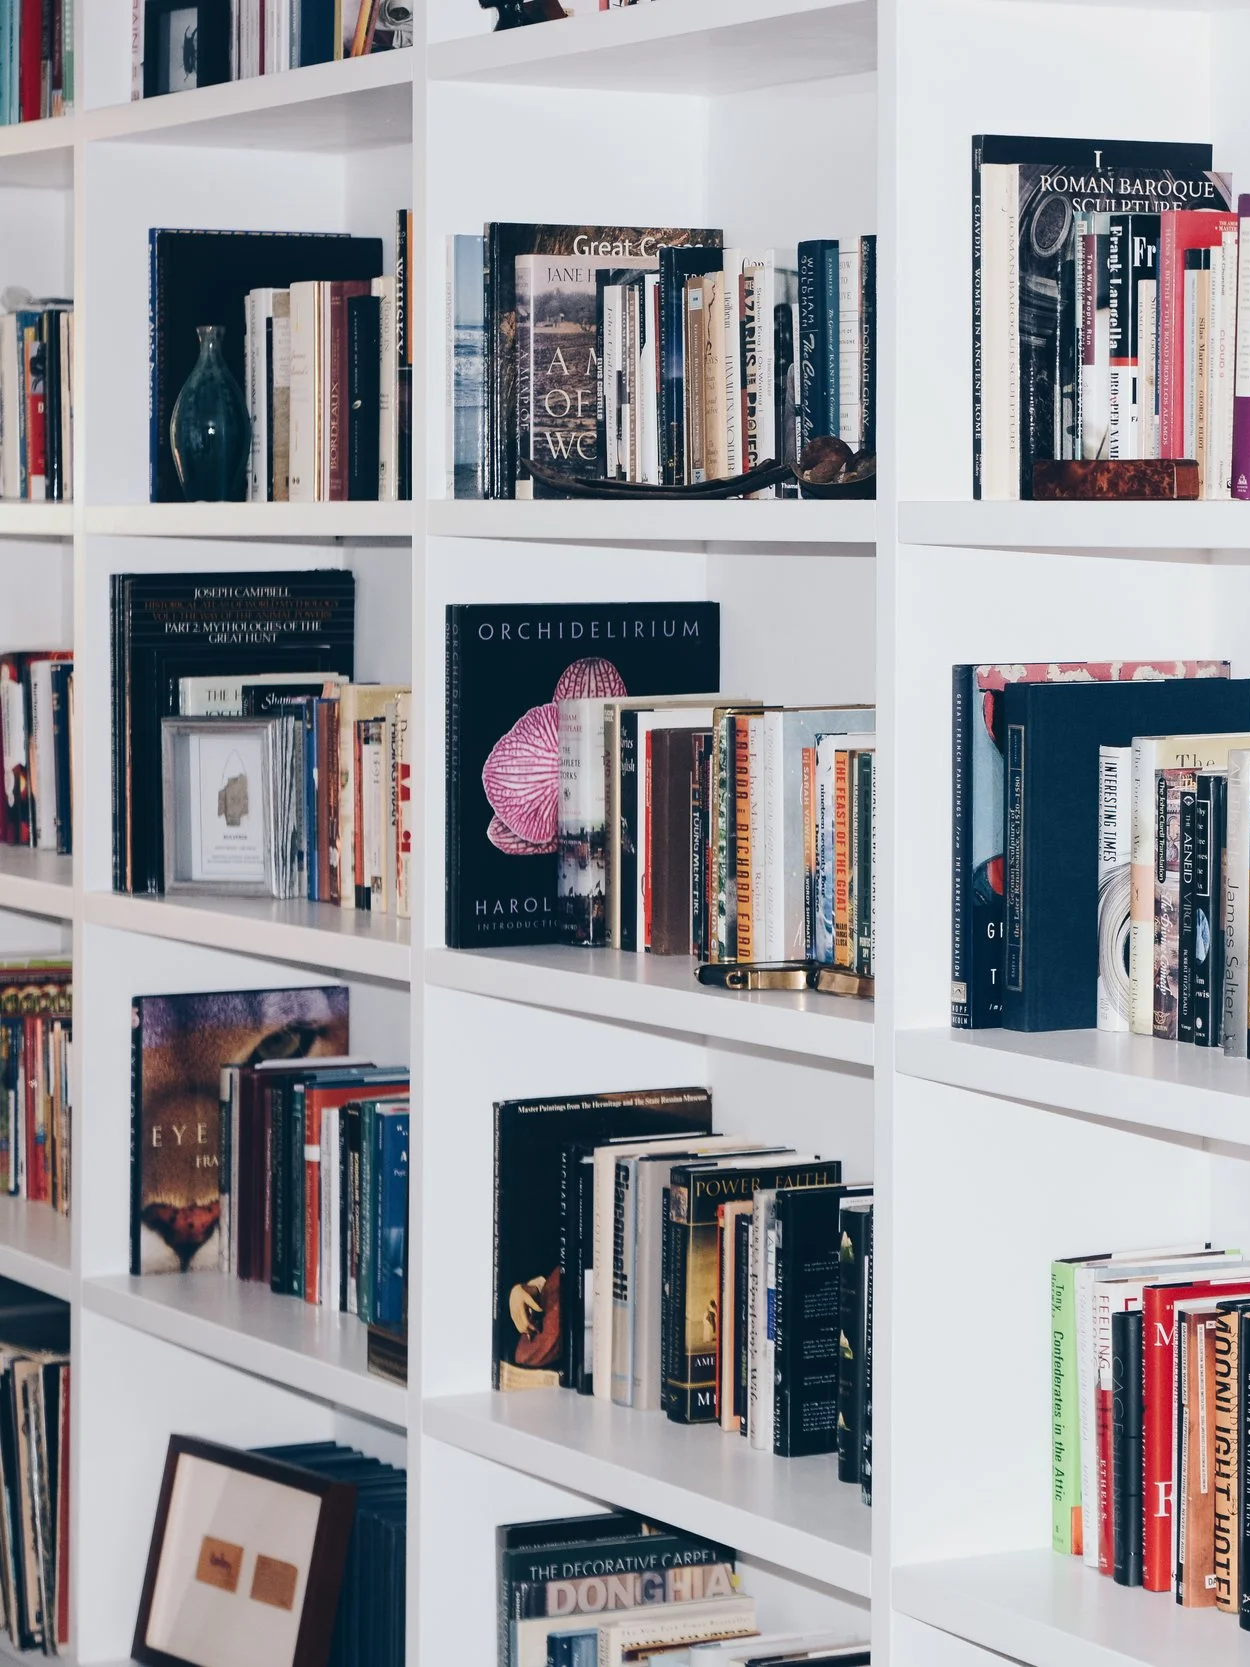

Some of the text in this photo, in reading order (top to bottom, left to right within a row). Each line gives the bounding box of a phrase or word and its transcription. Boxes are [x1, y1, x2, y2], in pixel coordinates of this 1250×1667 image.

[1040, 176, 1215, 198] ROMAN BAROQUE
[1072, 198, 1182, 213] SCULPTURE
[572, 234, 633, 258] Great
[547, 268, 584, 283] JANE
[800, 256, 808, 328] GOLDMAN
[806, 257, 815, 324] WILLIAM
[1109, 225, 1123, 350] Frank Langella
[974, 321, 980, 335] IN
[547, 347, 569, 375] A
[862, 323, 871, 426] DORIAN GRAY
[329, 381, 339, 471] BORDEAUX
[545, 389, 591, 417] OF
[193, 586, 291, 599] JOSEPH CAMPBELL
[202, 621, 282, 632] MYTHOLOGIES
[300, 621, 322, 631] THE
[208, 632, 245, 644] GREAT
[477, 620, 700, 641] ORCHIDELIRIUM
[835, 759, 848, 913] THE FEAST OF THE GOAT
[1104, 761, 1117, 863] INTERESTING TIMES
[692, 812, 701, 882] YOUNG MEN
[737, 823, 750, 904] RICHARD
[475, 897, 552, 915] HAROL
[1183, 832, 1193, 937] AENEID VIRGIL
[737, 912, 751, 958] FORD
[1226, 877, 1240, 1023] James Salter
[517, 1104, 537, 1113] Master
[539, 1103, 566, 1113] Paintings
[566, 1102, 580, 1110] from
[592, 1098, 622, 1109] Hermitage
[622, 1098, 633, 1107] and
[645, 1096, 660, 1105] State
[695, 1171, 829, 1198] POWER FAITH
[611, 1161, 631, 1303] Giacometti
[1099, 1295, 1111, 1370] FEELING
[1052, 1285, 1065, 1502] Tony Confederates in the Attic
[1215, 1310, 1232, 1606] MOONLIGHT HOTEL
[529, 1565, 558, 1581] THE
[562, 1556, 658, 1579] DECORATIVE
[545, 1564, 737, 1617] DONGHIA
